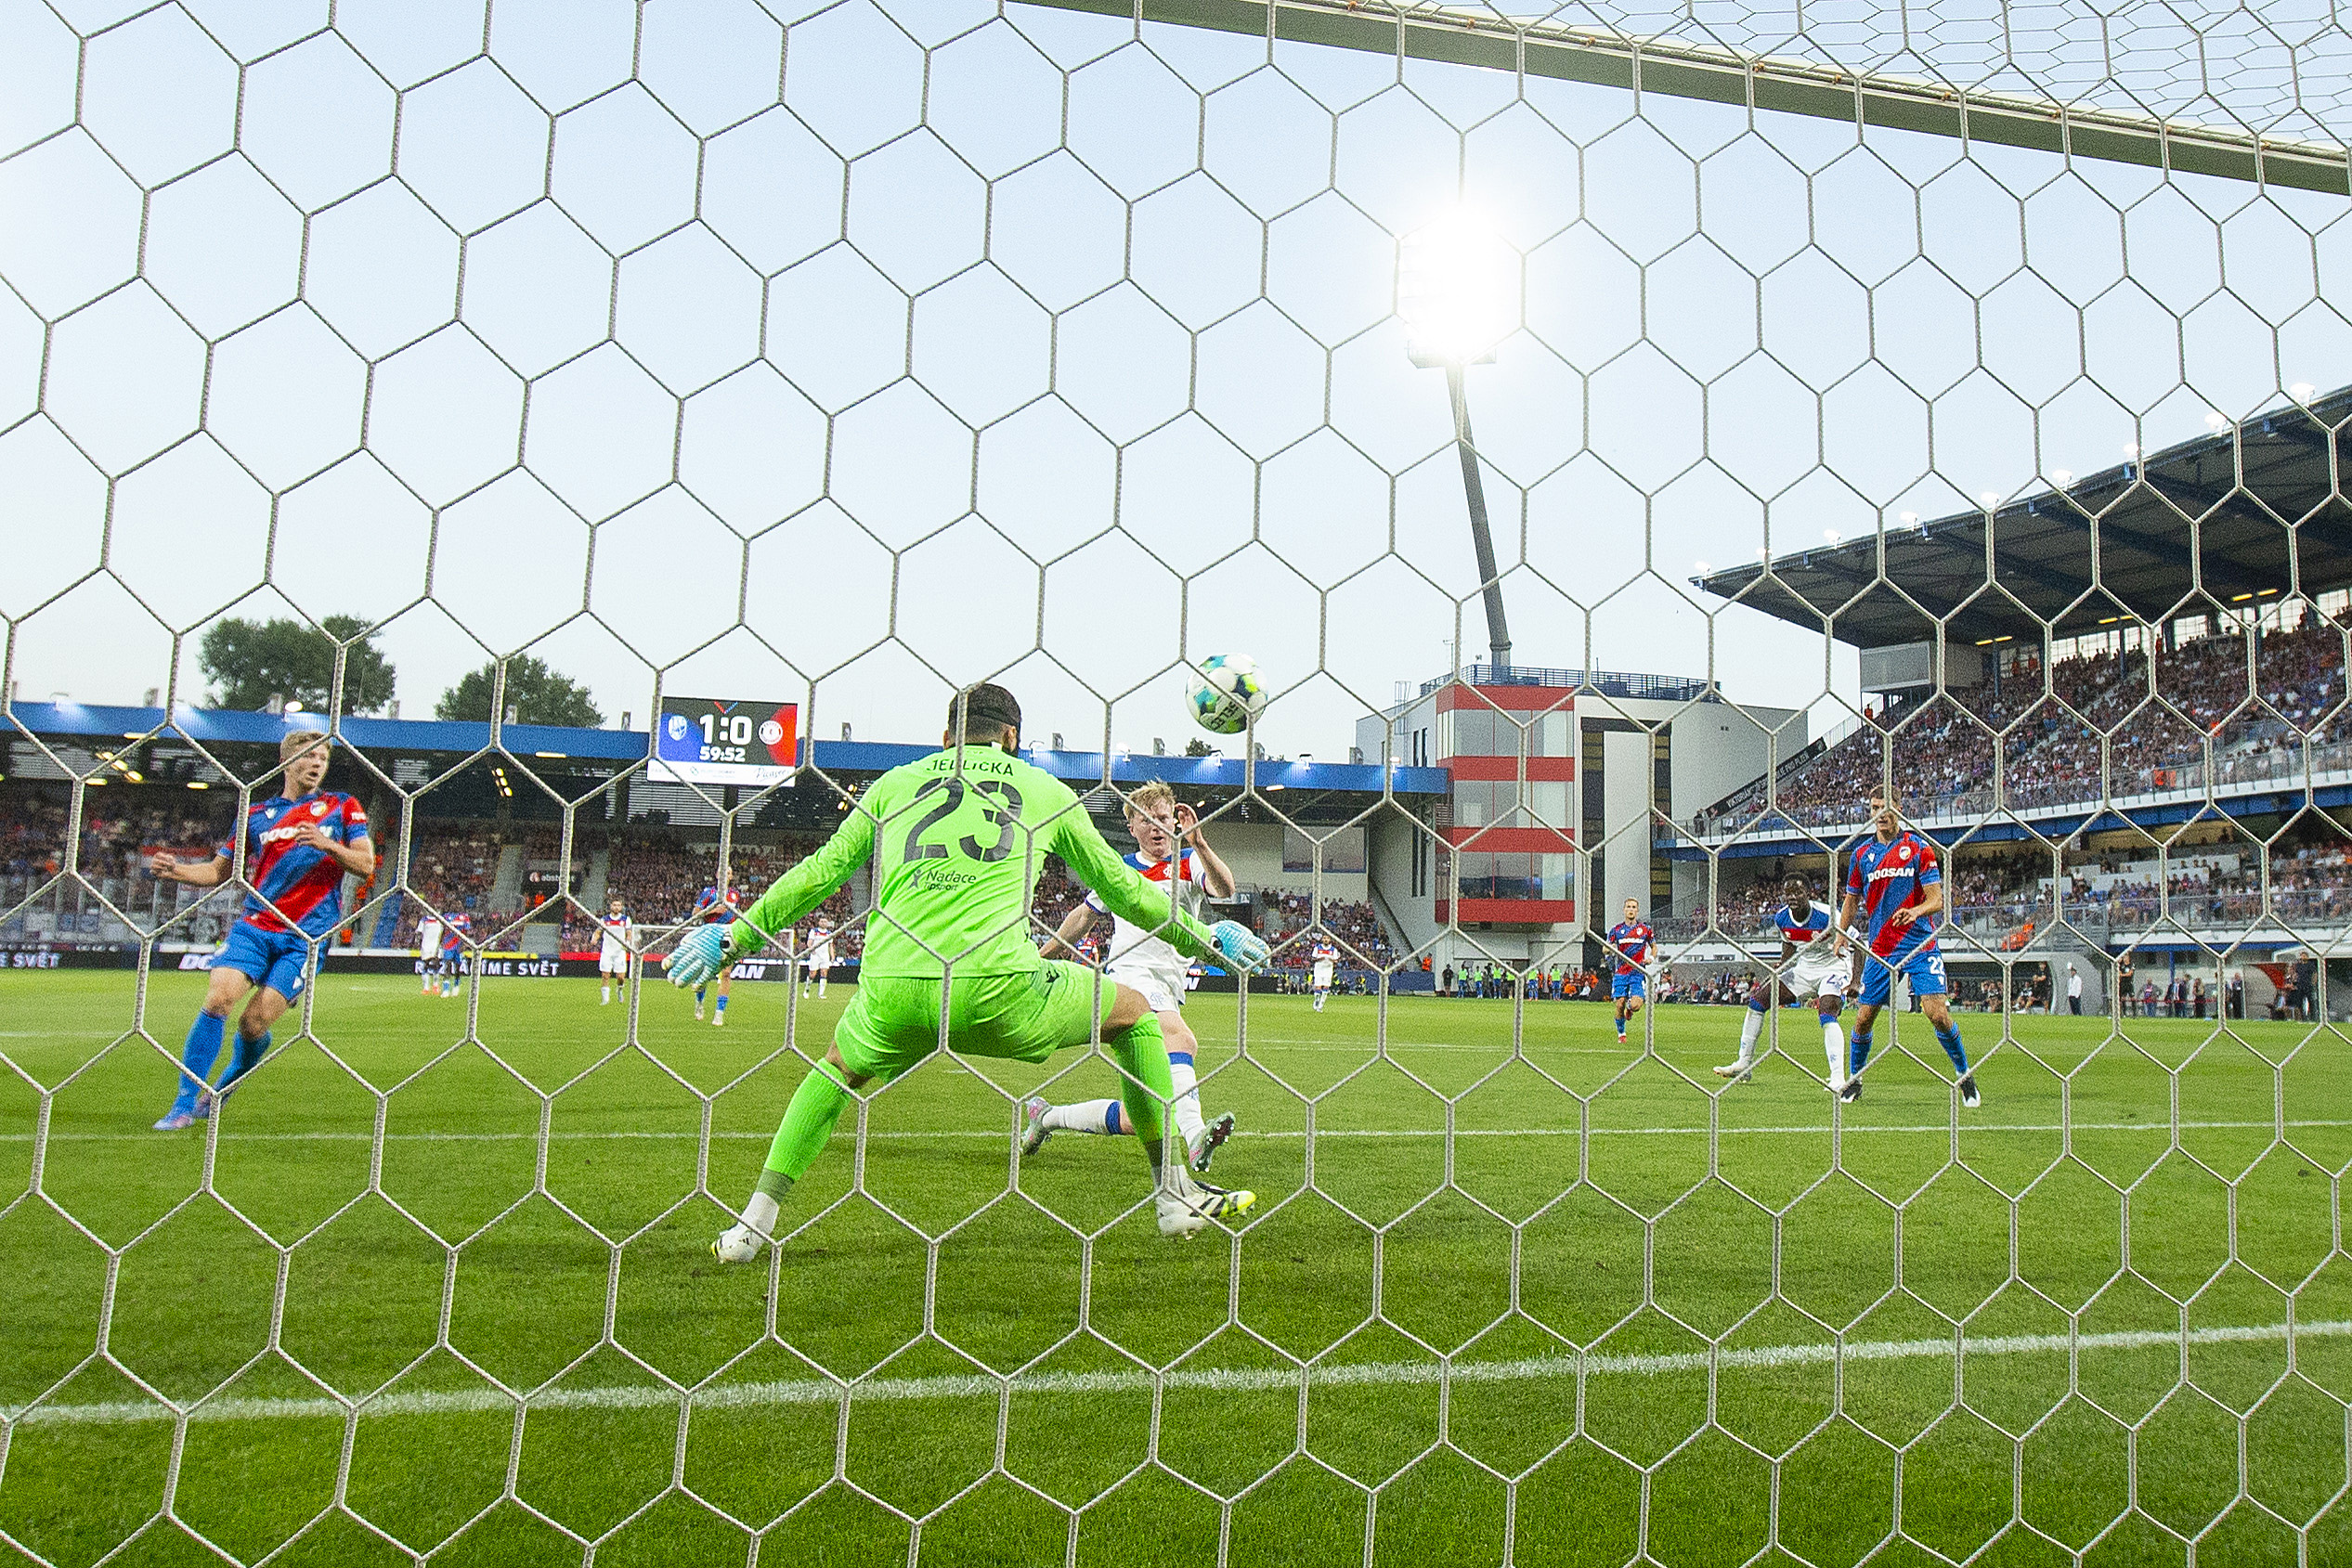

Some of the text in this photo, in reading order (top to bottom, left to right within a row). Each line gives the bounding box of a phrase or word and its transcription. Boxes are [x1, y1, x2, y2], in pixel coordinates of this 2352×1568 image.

[699, 714, 752, 745] 1:0
[699, 746, 746, 762] 59:52
[903, 777, 1022, 863] 23
[259, 825, 333, 846] DOON
[927, 870, 977, 884] Nadace
[1867, 867, 1915, 883] DOOSAN
[517, 960, 559, 976] SVĚT
